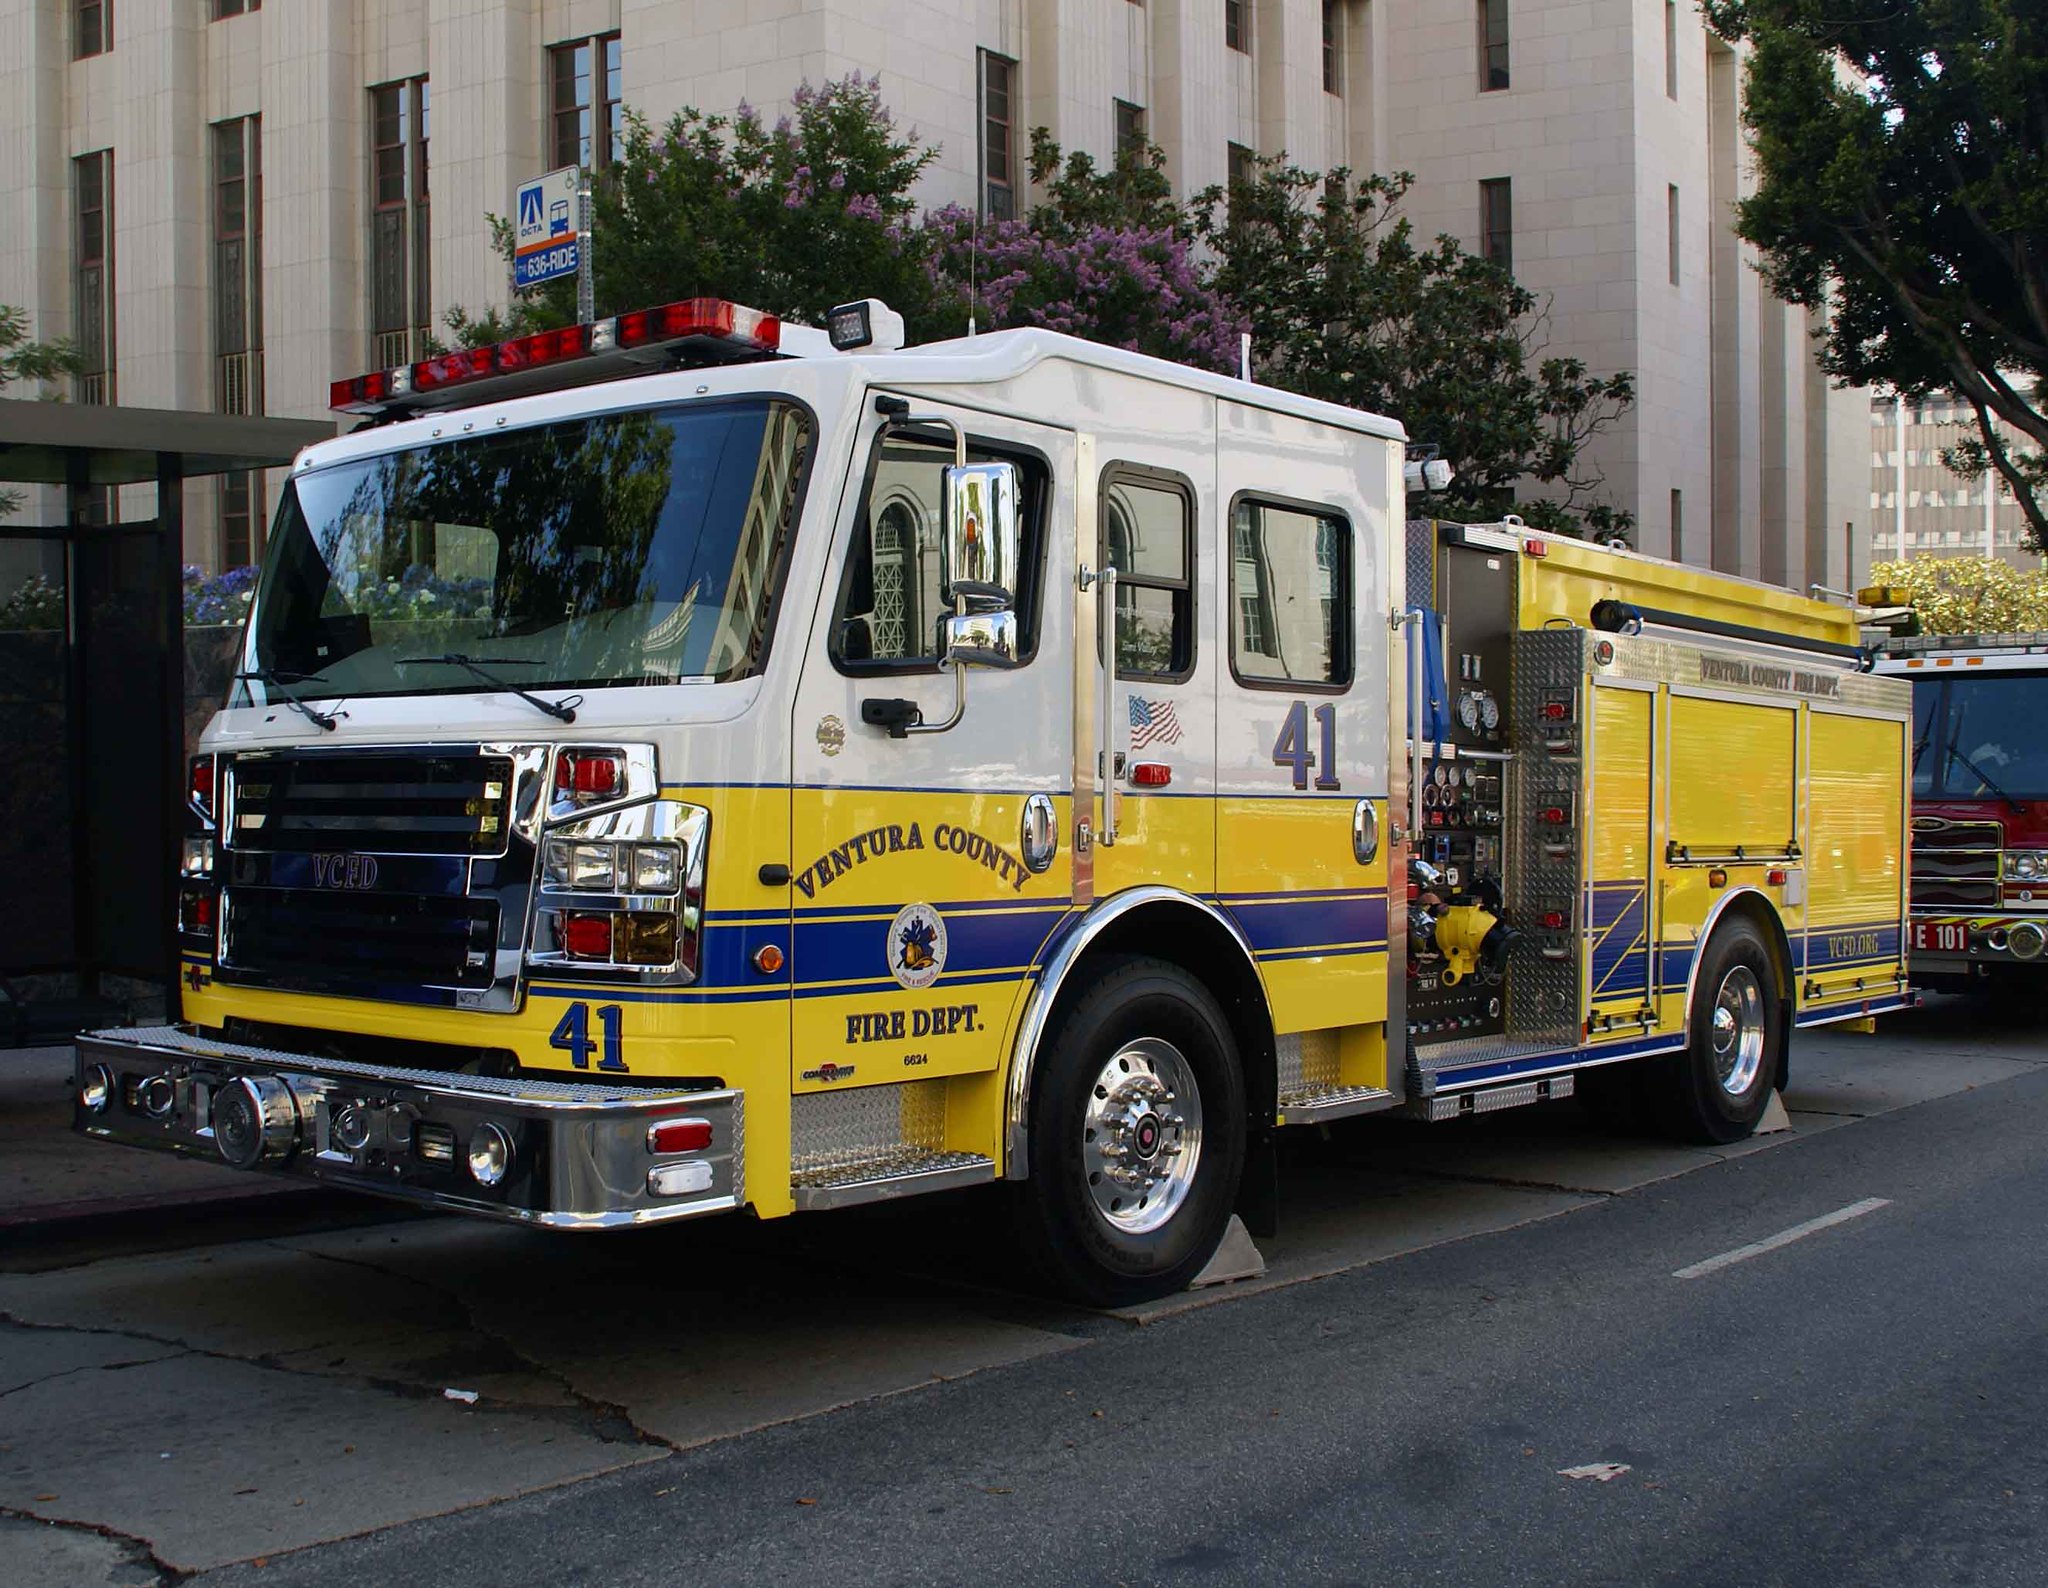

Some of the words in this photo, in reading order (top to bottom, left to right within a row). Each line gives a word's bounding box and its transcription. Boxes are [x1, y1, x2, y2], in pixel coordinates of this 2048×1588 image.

[521, 224, 543, 236] OCTA
[528, 246, 576, 278] 636-RIDE
[1272, 700, 1341, 791] 41
[312, 853, 378, 889] VCFD
[794, 821, 924, 900] VENTURA
[933, 823, 1032, 893] COUNTY
[1829, 933, 1879, 958] VCFD.ORG
[1916, 925, 1927, 949] E
[1936, 925, 1965, 950] 101
[549, 1001, 629, 1073] 41
[845, 1010, 906, 1044] FIRE
[911, 1004, 985, 1038] DEPT.
[903, 1054, 928, 1066] 6624
